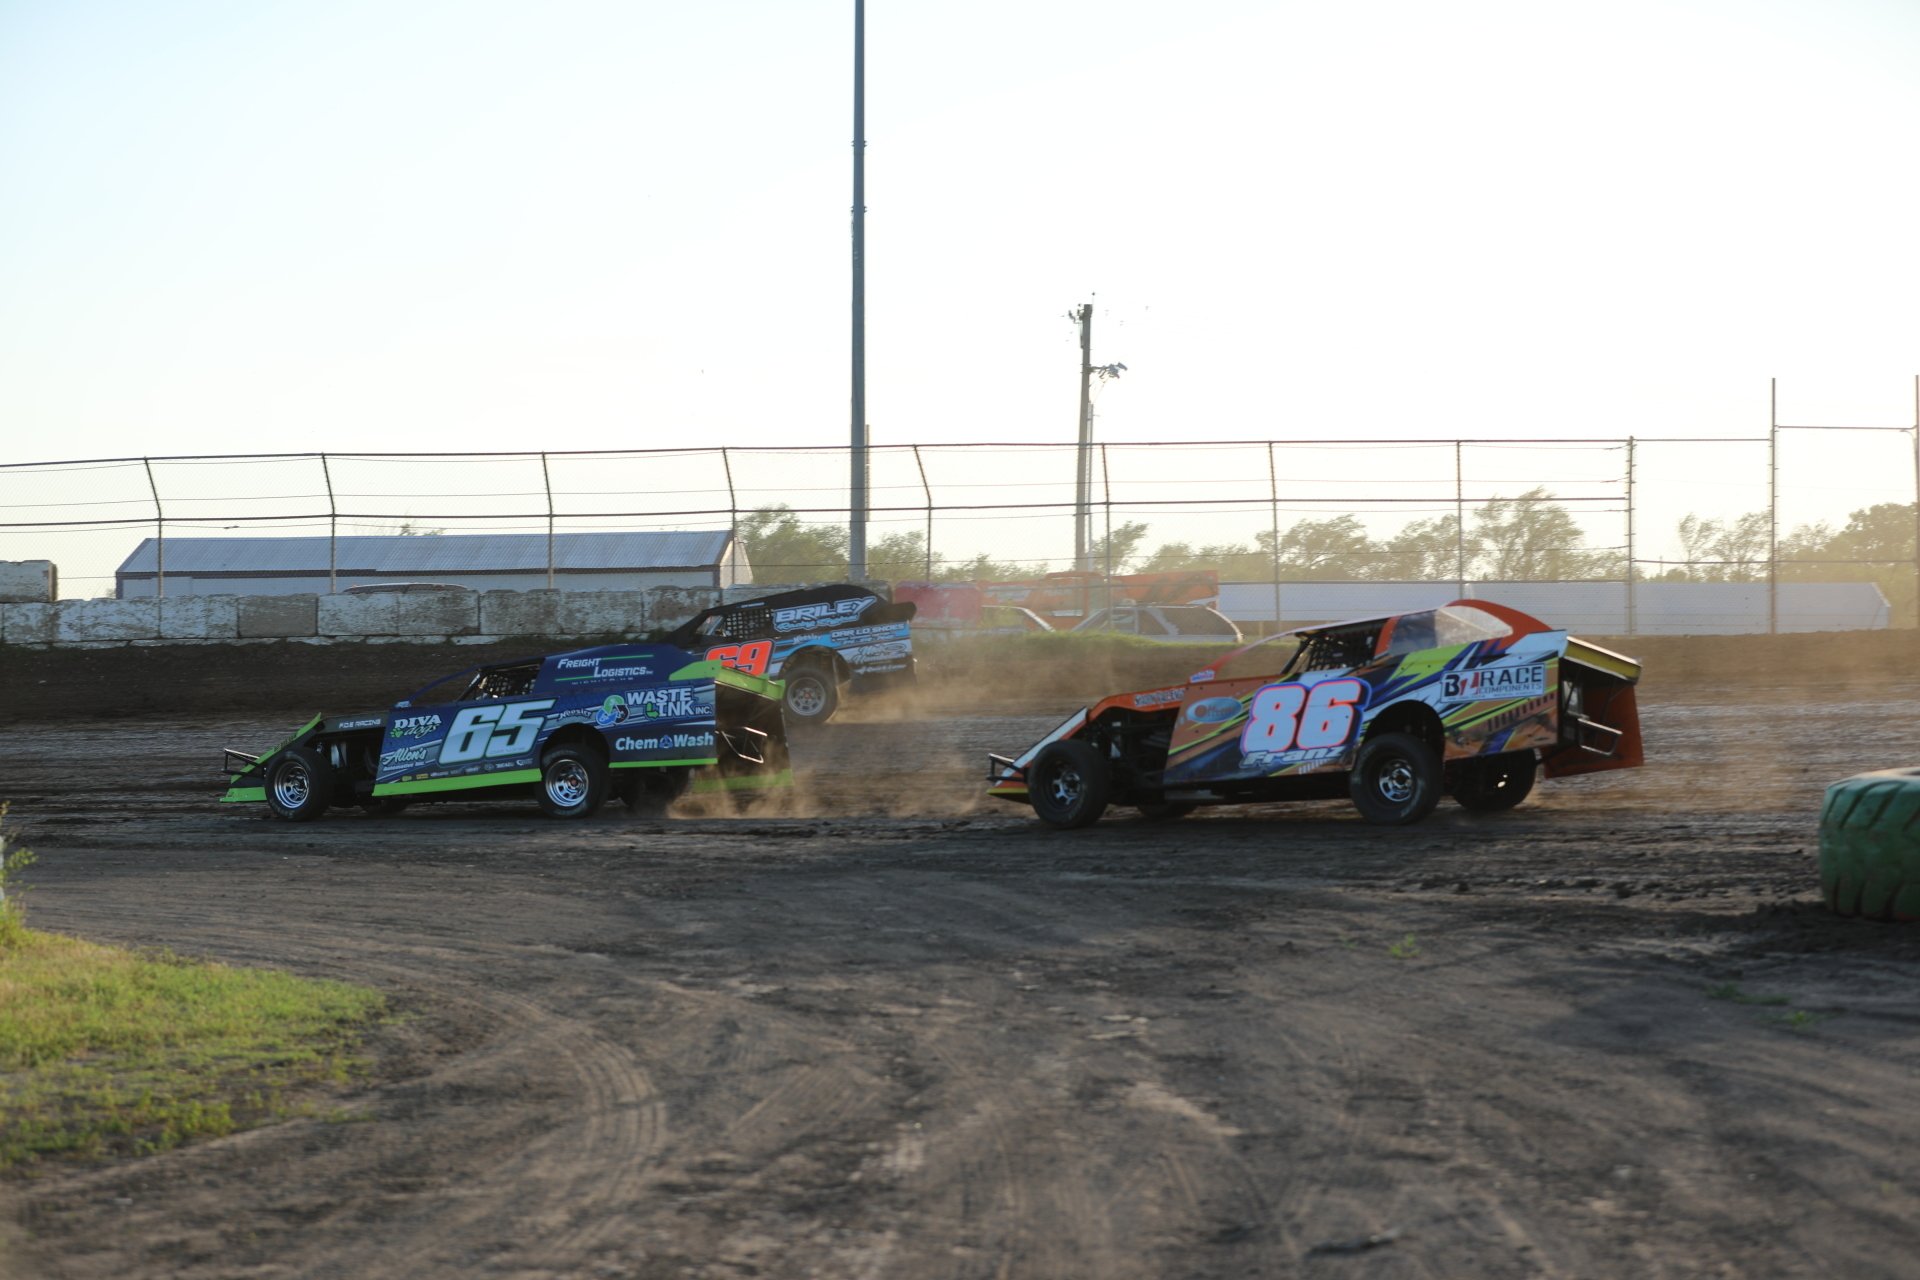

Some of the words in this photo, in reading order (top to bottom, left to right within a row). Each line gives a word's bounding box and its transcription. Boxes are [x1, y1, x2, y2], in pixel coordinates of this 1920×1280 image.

[776, 596, 877, 623] BRILEY
[594, 666, 646, 678] LOGISTICS
[1481, 667, 1542, 686] RACE
[627, 688, 692, 705] WASTE
[695, 706, 713, 715] INC.
[1242, 679, 1364, 753] 86
[394, 714, 442, 729] DIVA
[439, 699, 557, 765] 65
[615, 736, 658, 751] Chem
[673, 732, 714, 748] Wash
[1243, 746, 1346, 766] Franz
